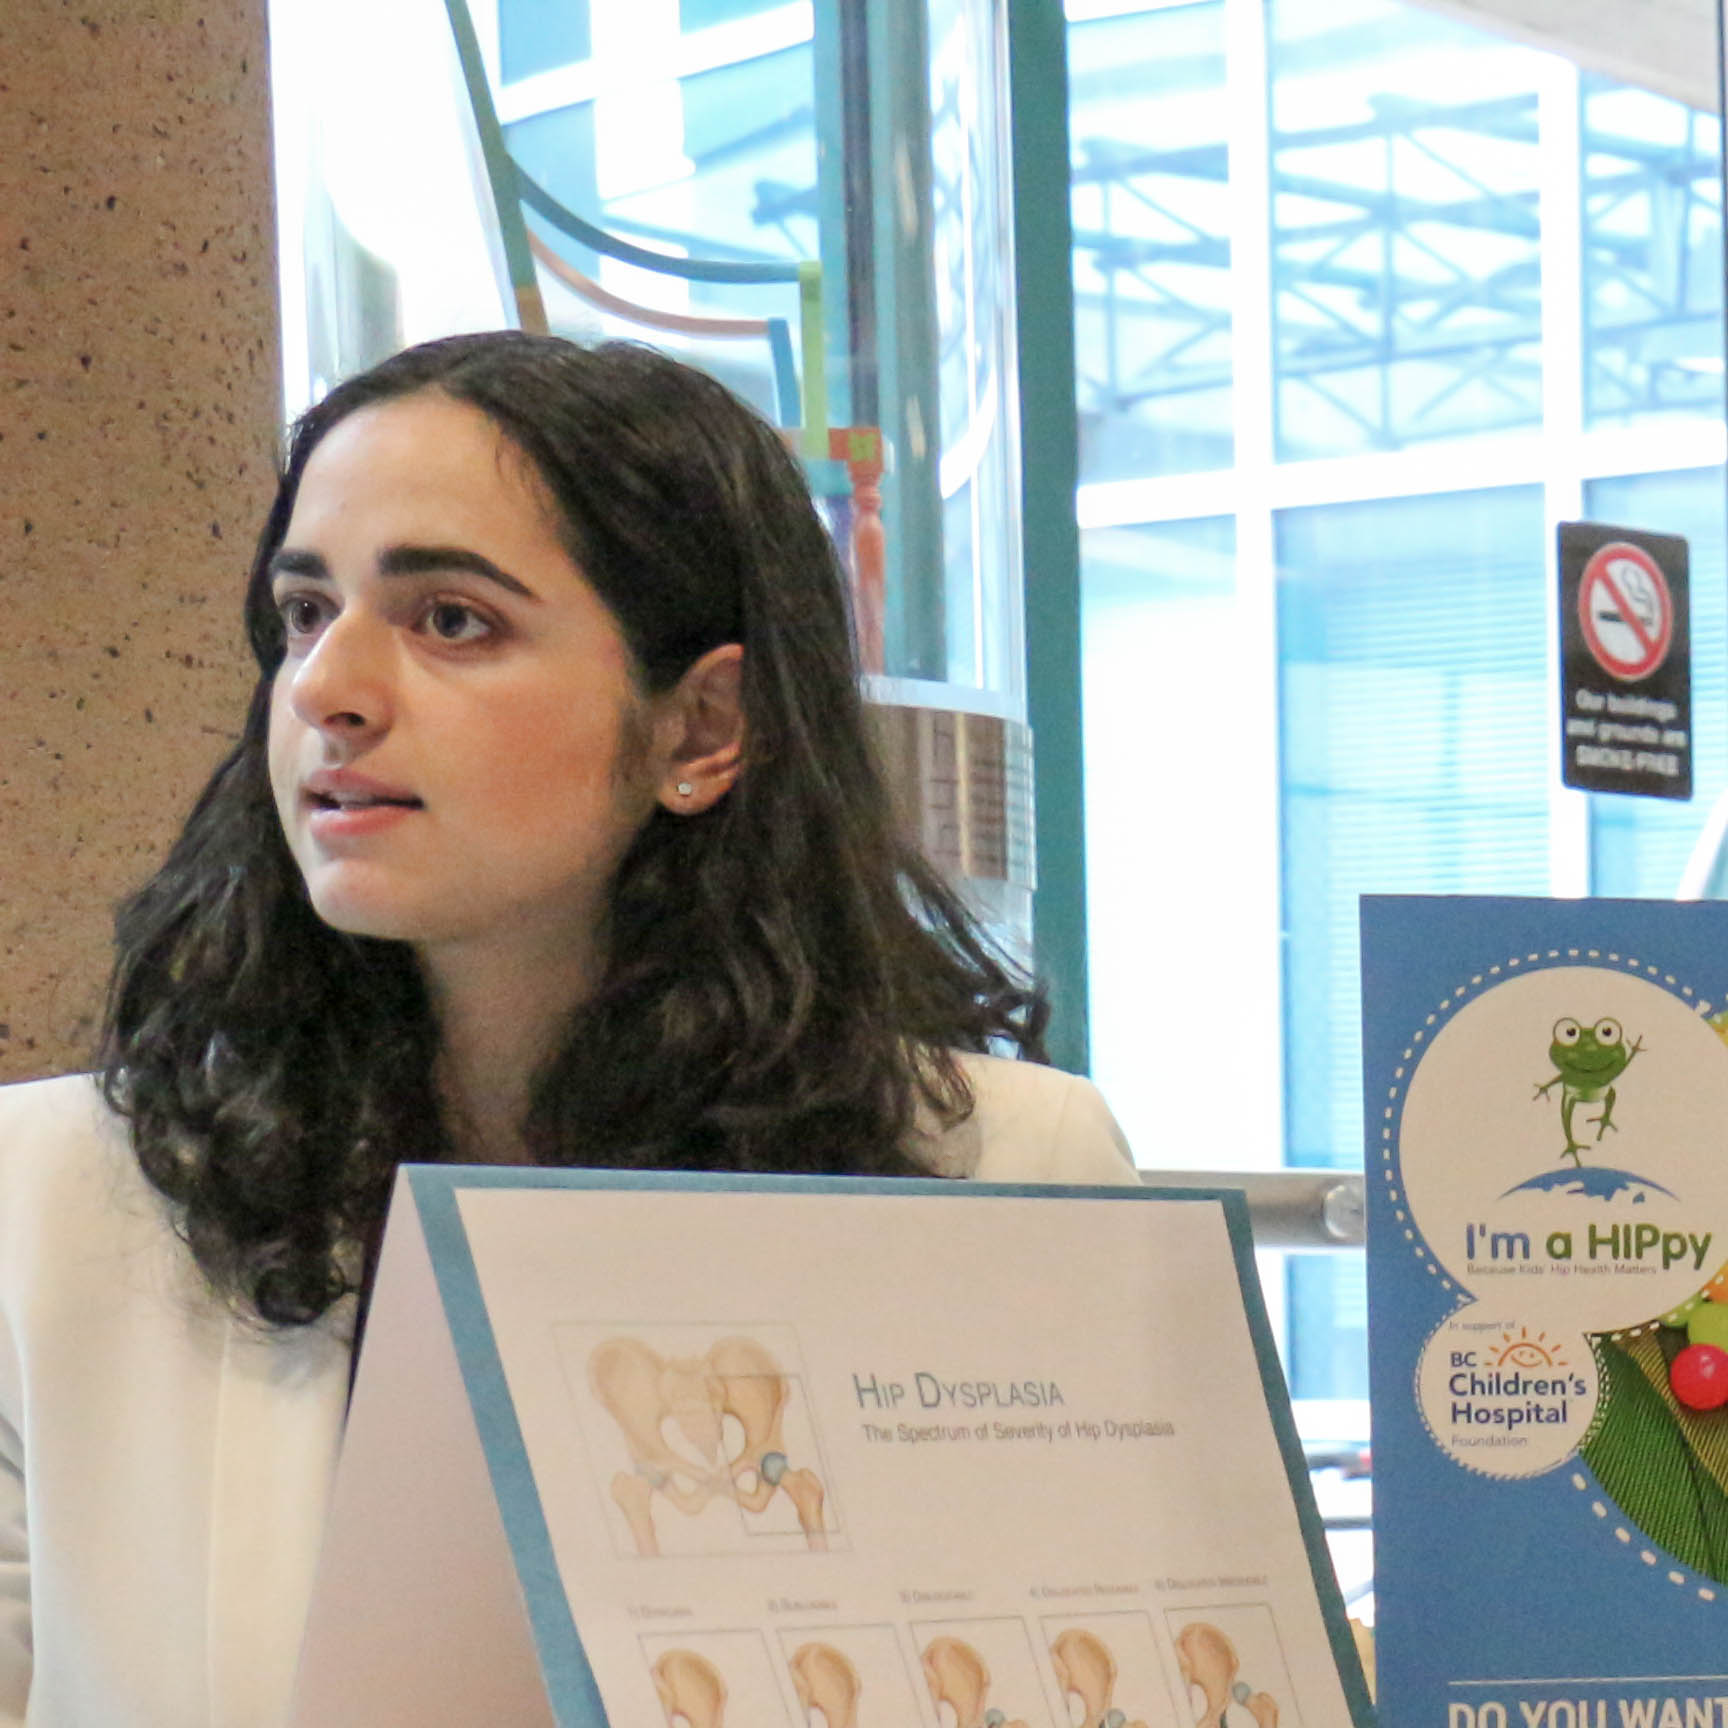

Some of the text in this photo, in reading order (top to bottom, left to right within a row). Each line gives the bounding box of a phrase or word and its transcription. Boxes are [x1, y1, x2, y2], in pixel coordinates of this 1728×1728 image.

[1466, 1223, 1713, 1271] I'm a HIPpy
[1450, 1351, 1477, 1368] BC
[1449, 1371, 1587, 1397] Children's
[1451, 1400, 1567, 1431] Hospital
[862, 1418, 1176, 1444] The Spectrum of Severity of Hip Dysplasia
[1451, 1434, 1528, 1447] Foundation
